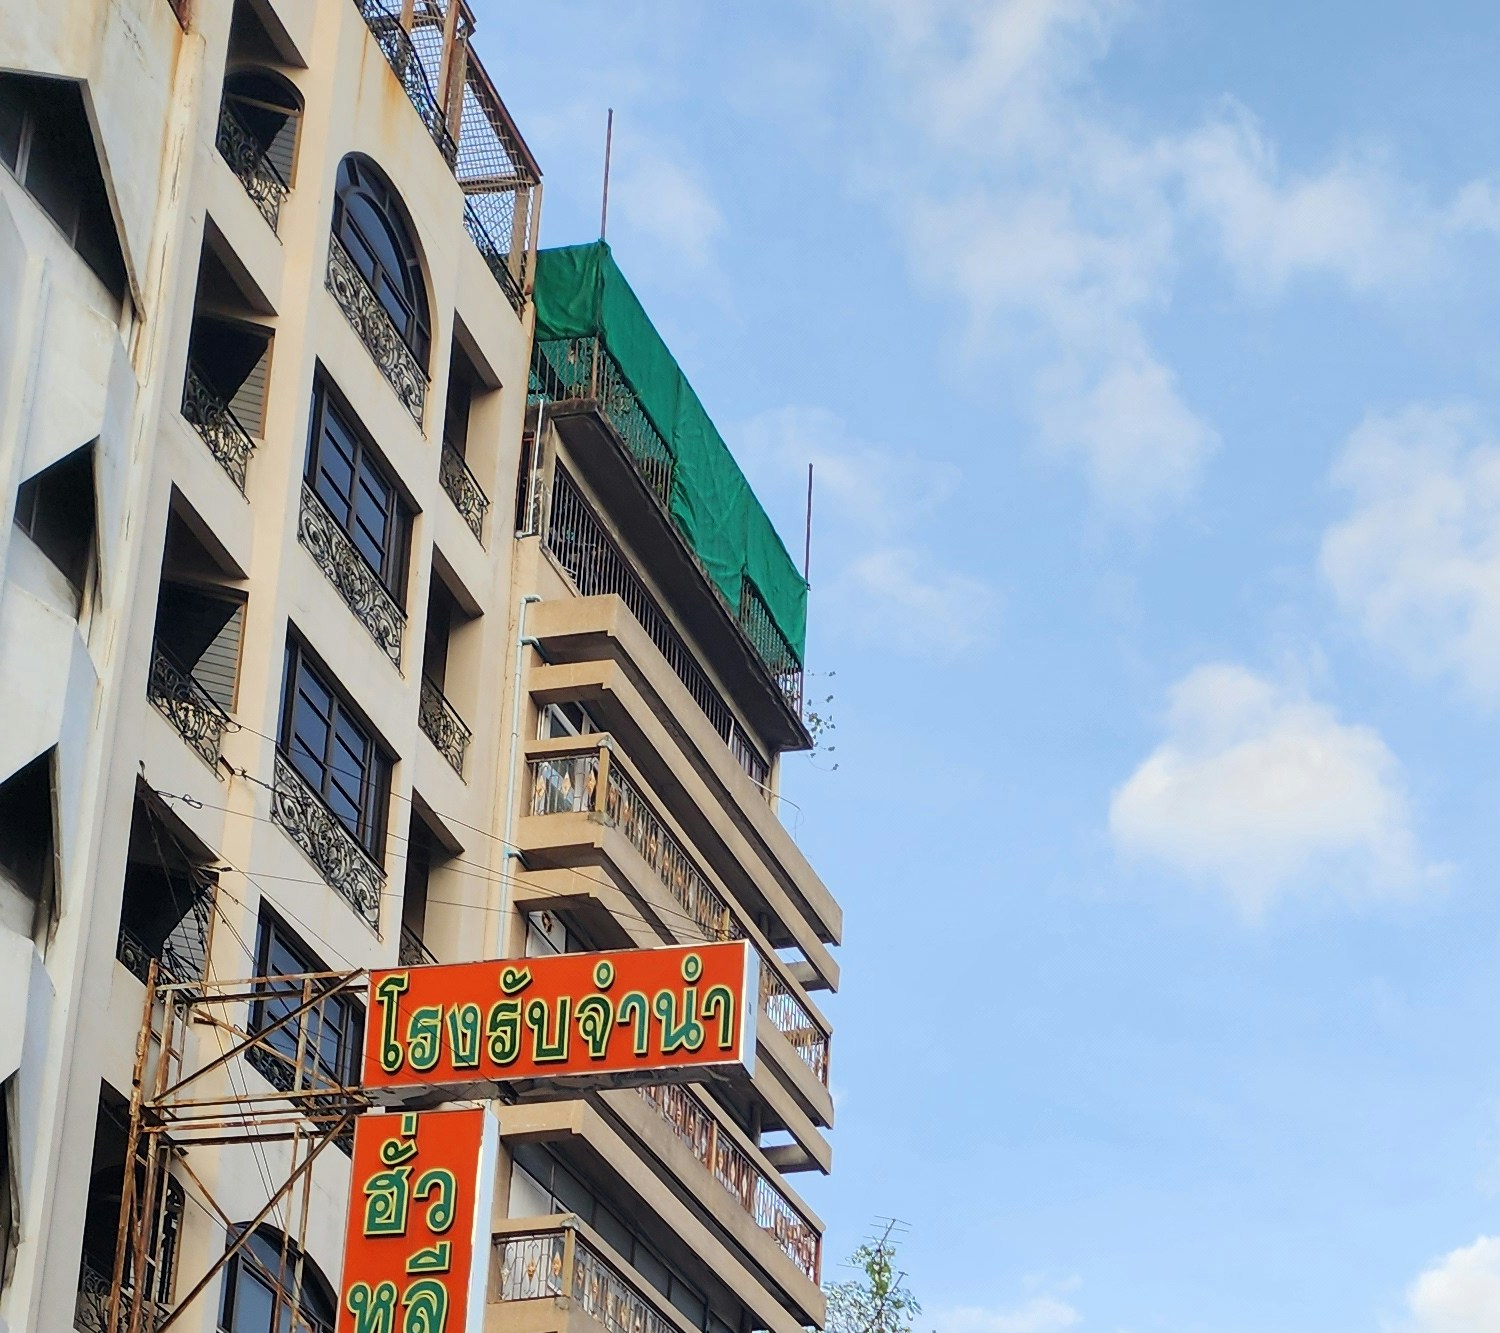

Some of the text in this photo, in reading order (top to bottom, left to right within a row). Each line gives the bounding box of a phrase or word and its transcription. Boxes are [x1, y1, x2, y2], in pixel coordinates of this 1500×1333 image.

[377, 953, 734, 1072] โรงรับจำนำ
[363, 1113, 456, 1236] ฮั่ว
